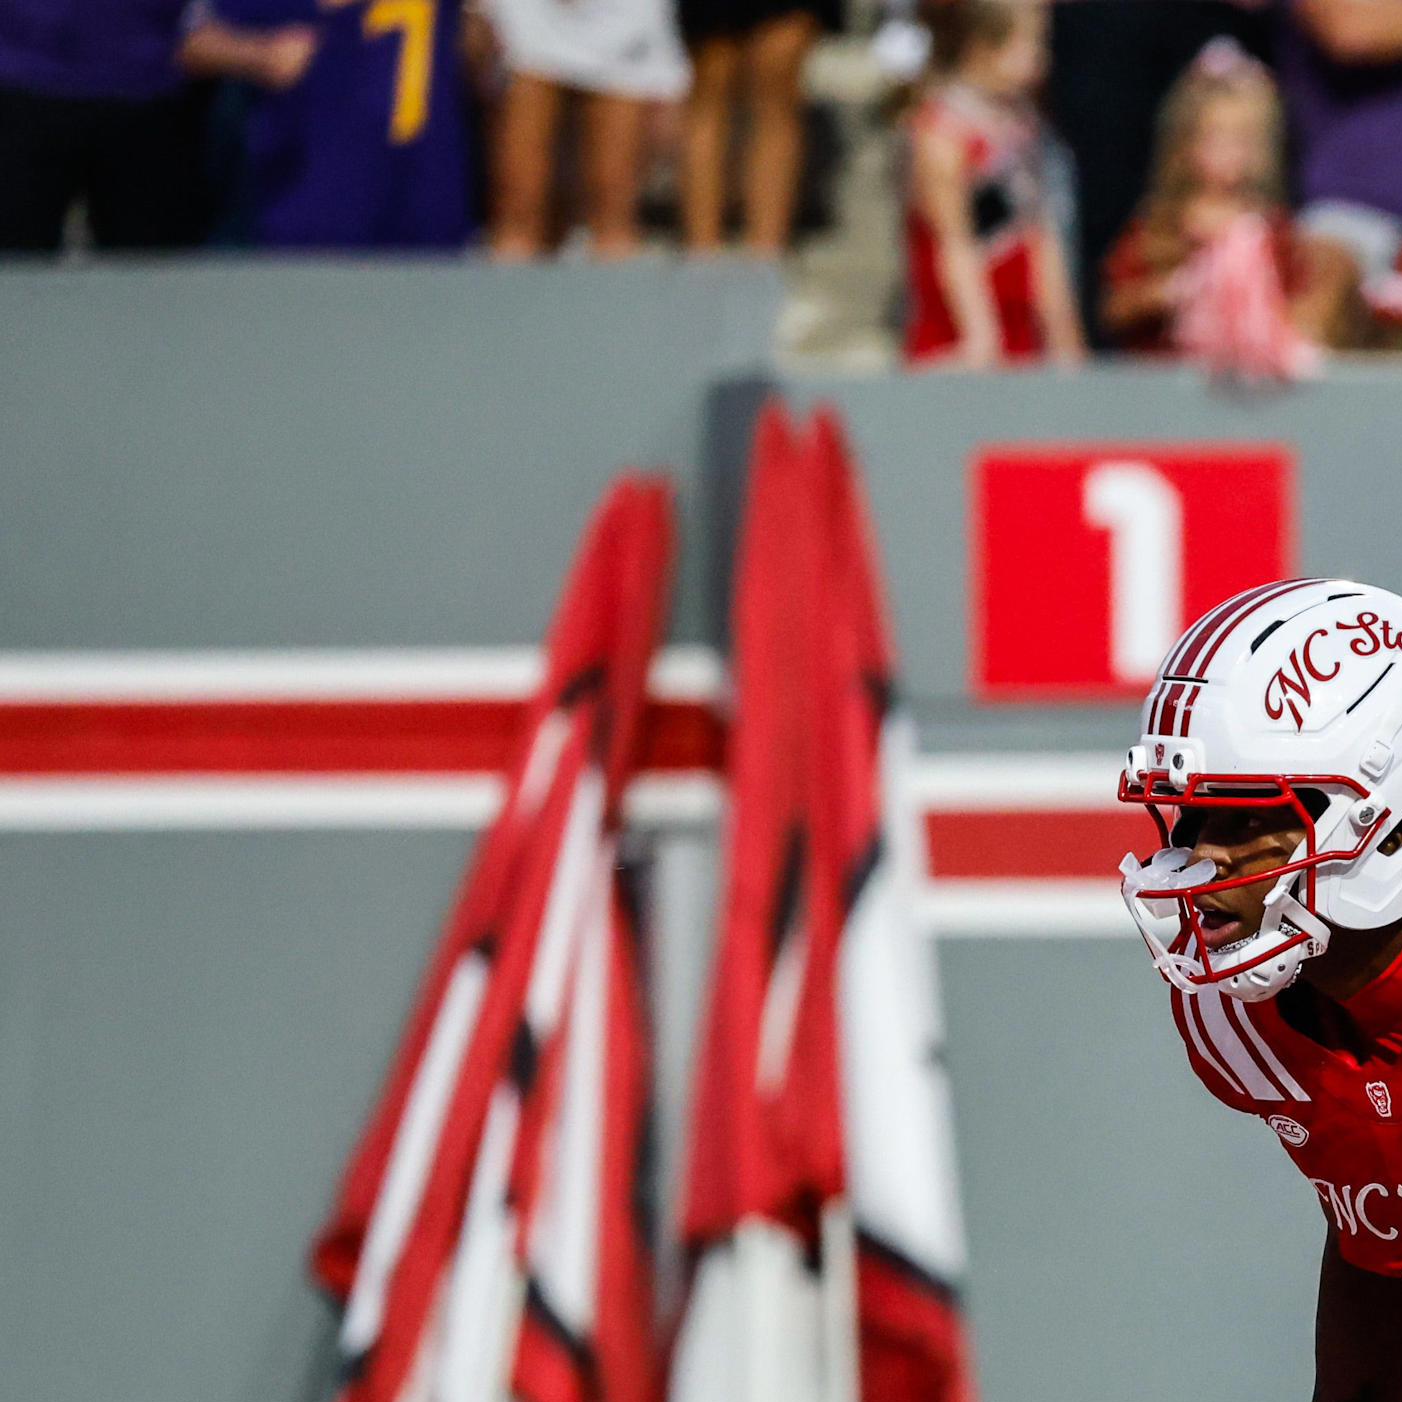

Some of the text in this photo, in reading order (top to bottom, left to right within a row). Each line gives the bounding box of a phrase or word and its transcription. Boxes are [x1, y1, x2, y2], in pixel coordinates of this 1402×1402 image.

[1083, 460, 1183, 684] 1
[1264, 629, 1341, 733] NC
[1276, 1121, 1301, 1137] ACC
[1308, 1177, 1399, 1241] NC
